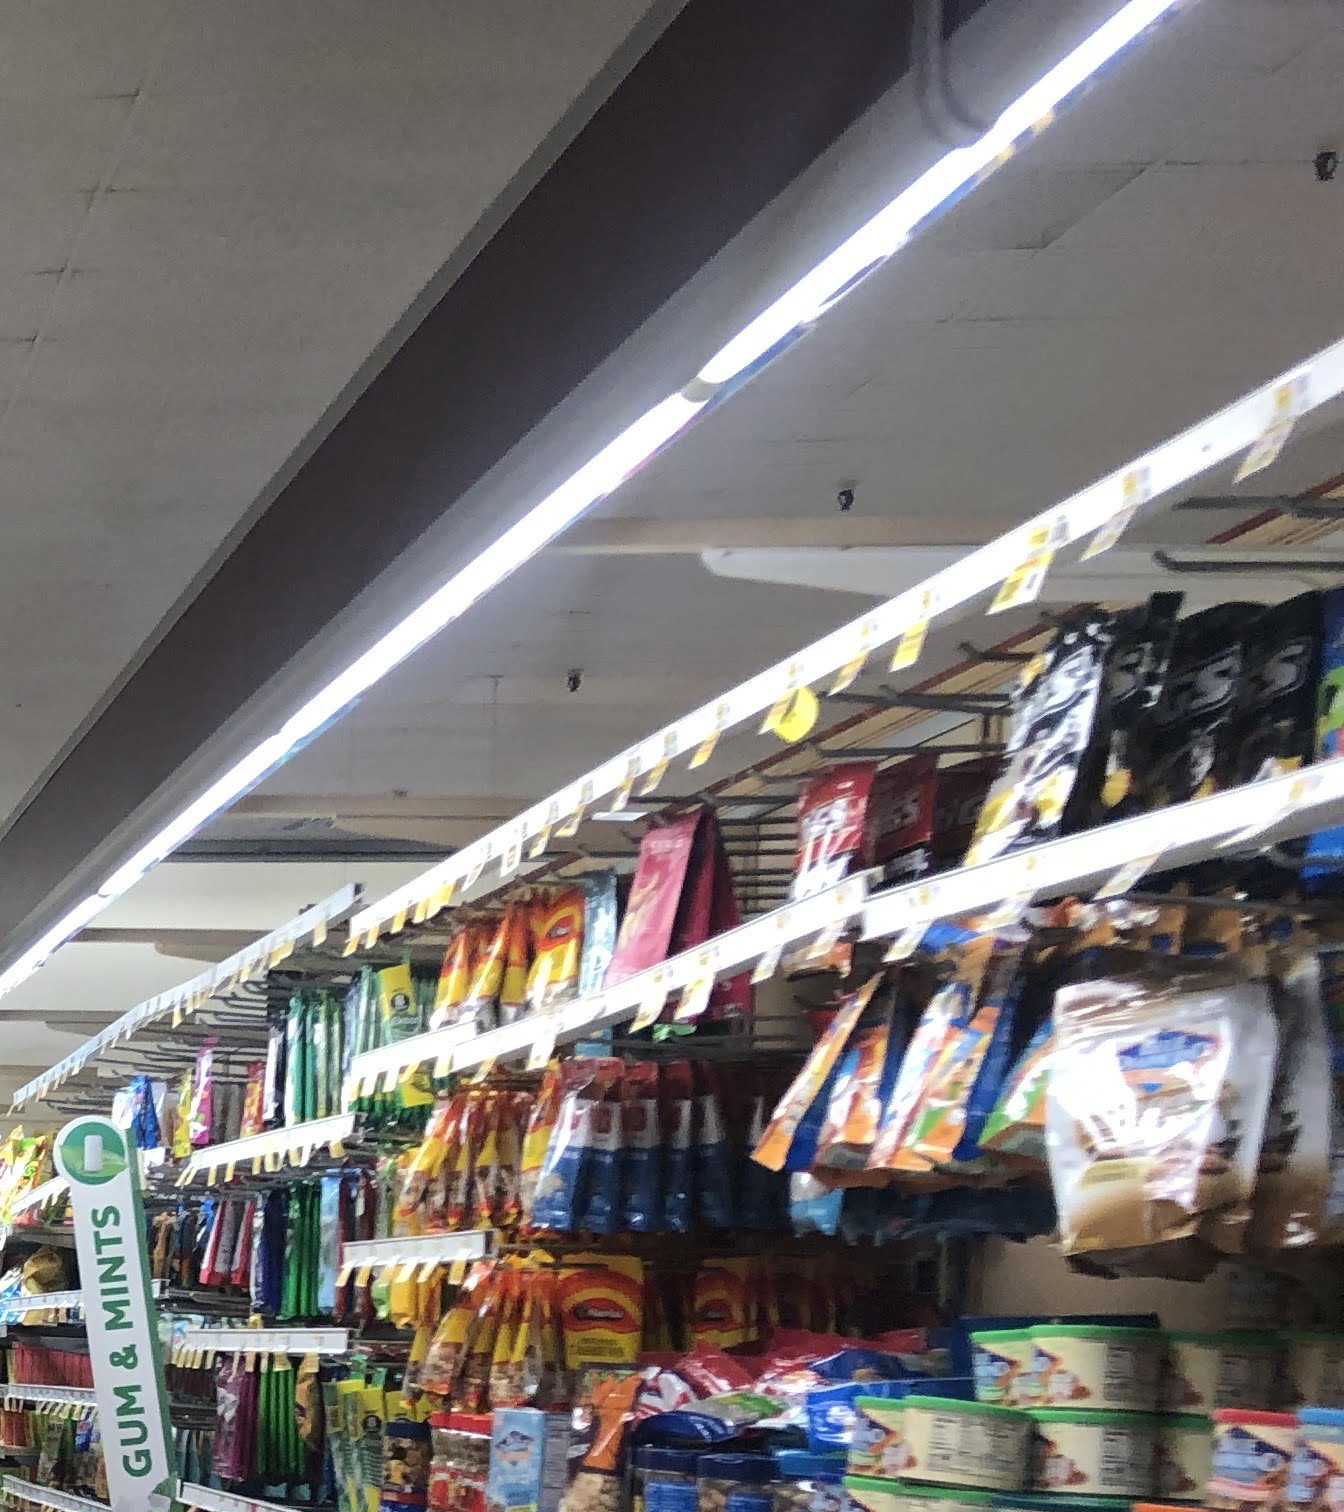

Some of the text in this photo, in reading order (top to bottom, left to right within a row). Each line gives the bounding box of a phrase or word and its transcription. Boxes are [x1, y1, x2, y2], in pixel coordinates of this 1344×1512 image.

[90, 1204, 154, 1479] GUM & MINTS
